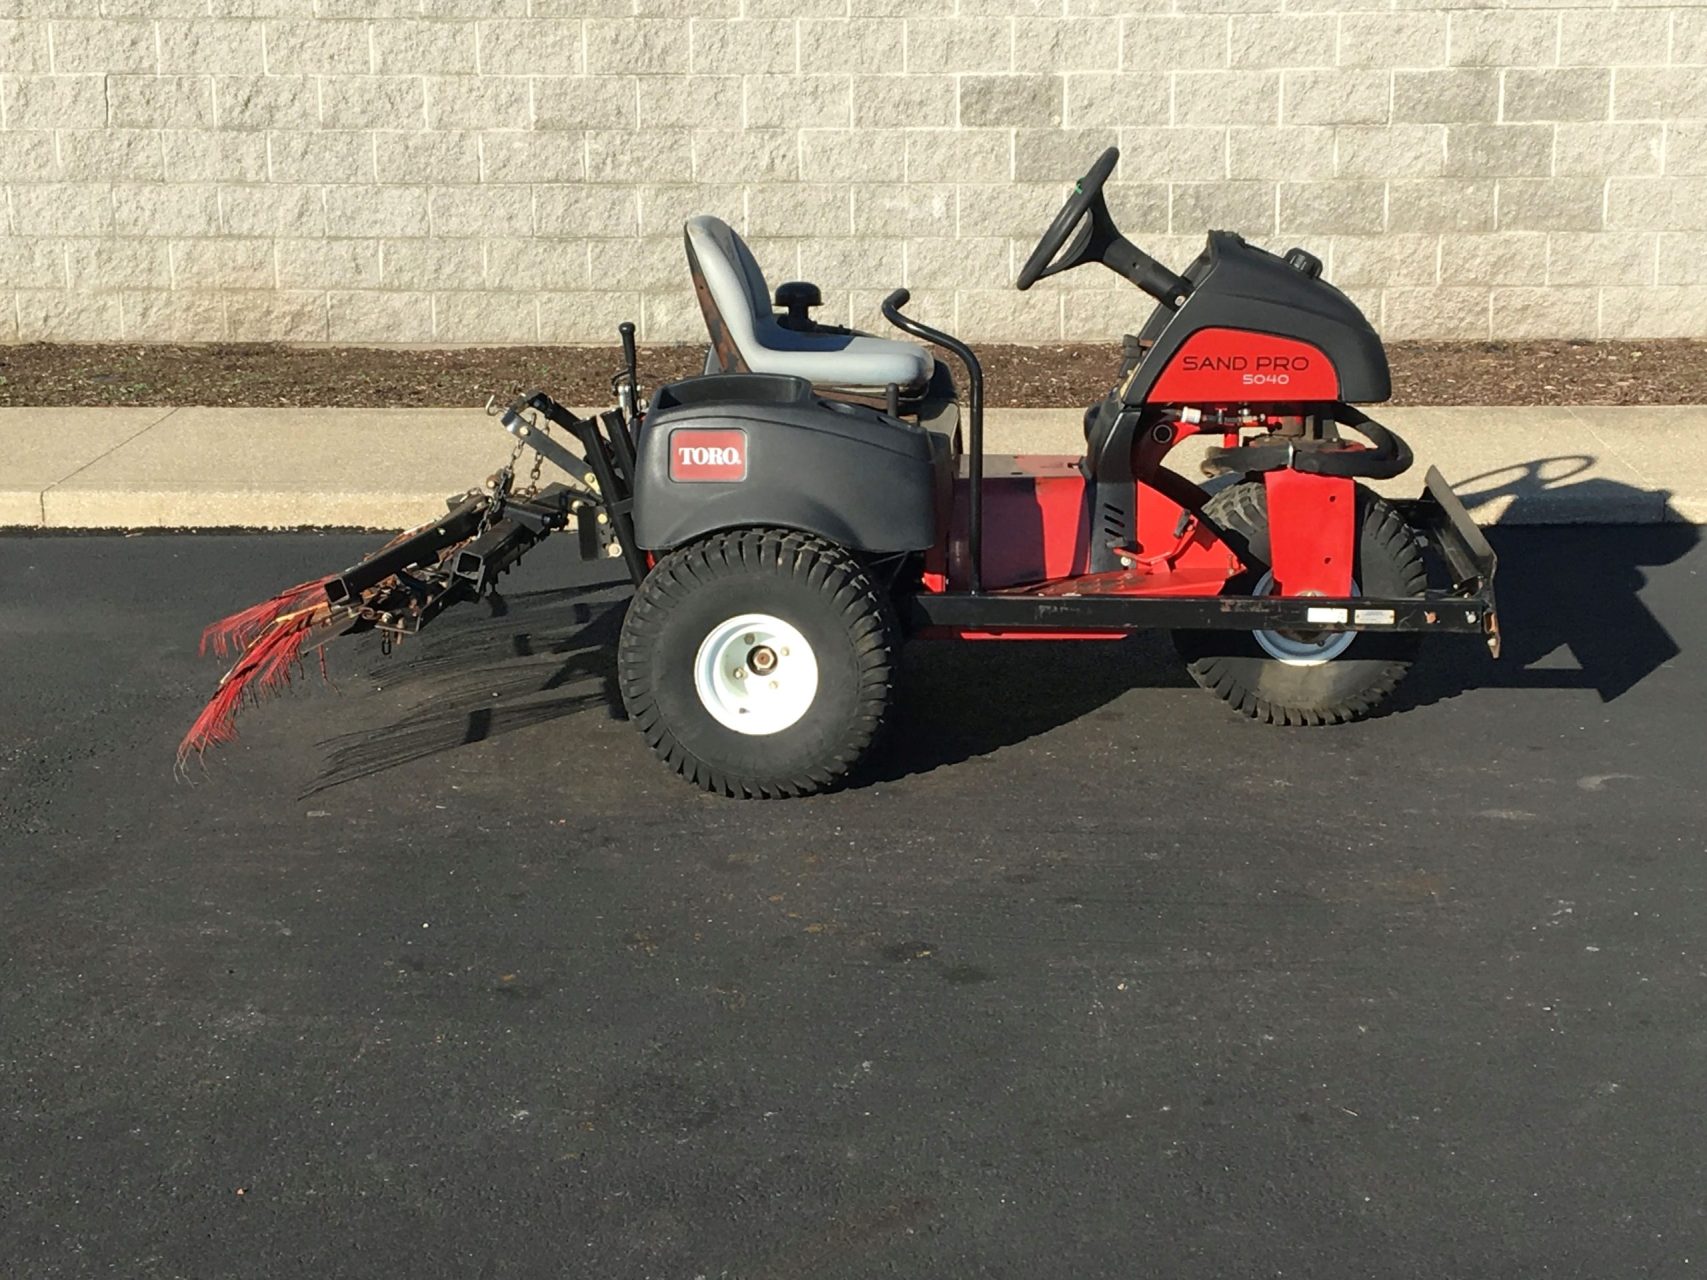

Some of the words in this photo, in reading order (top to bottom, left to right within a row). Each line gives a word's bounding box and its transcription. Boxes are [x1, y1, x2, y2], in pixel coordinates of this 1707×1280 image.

[1183, 356, 1248, 371] SAND
[1256, 356, 1309, 371] PRO
[1242, 374, 1289, 385] 5040
[678, 447, 741, 465] TORO
